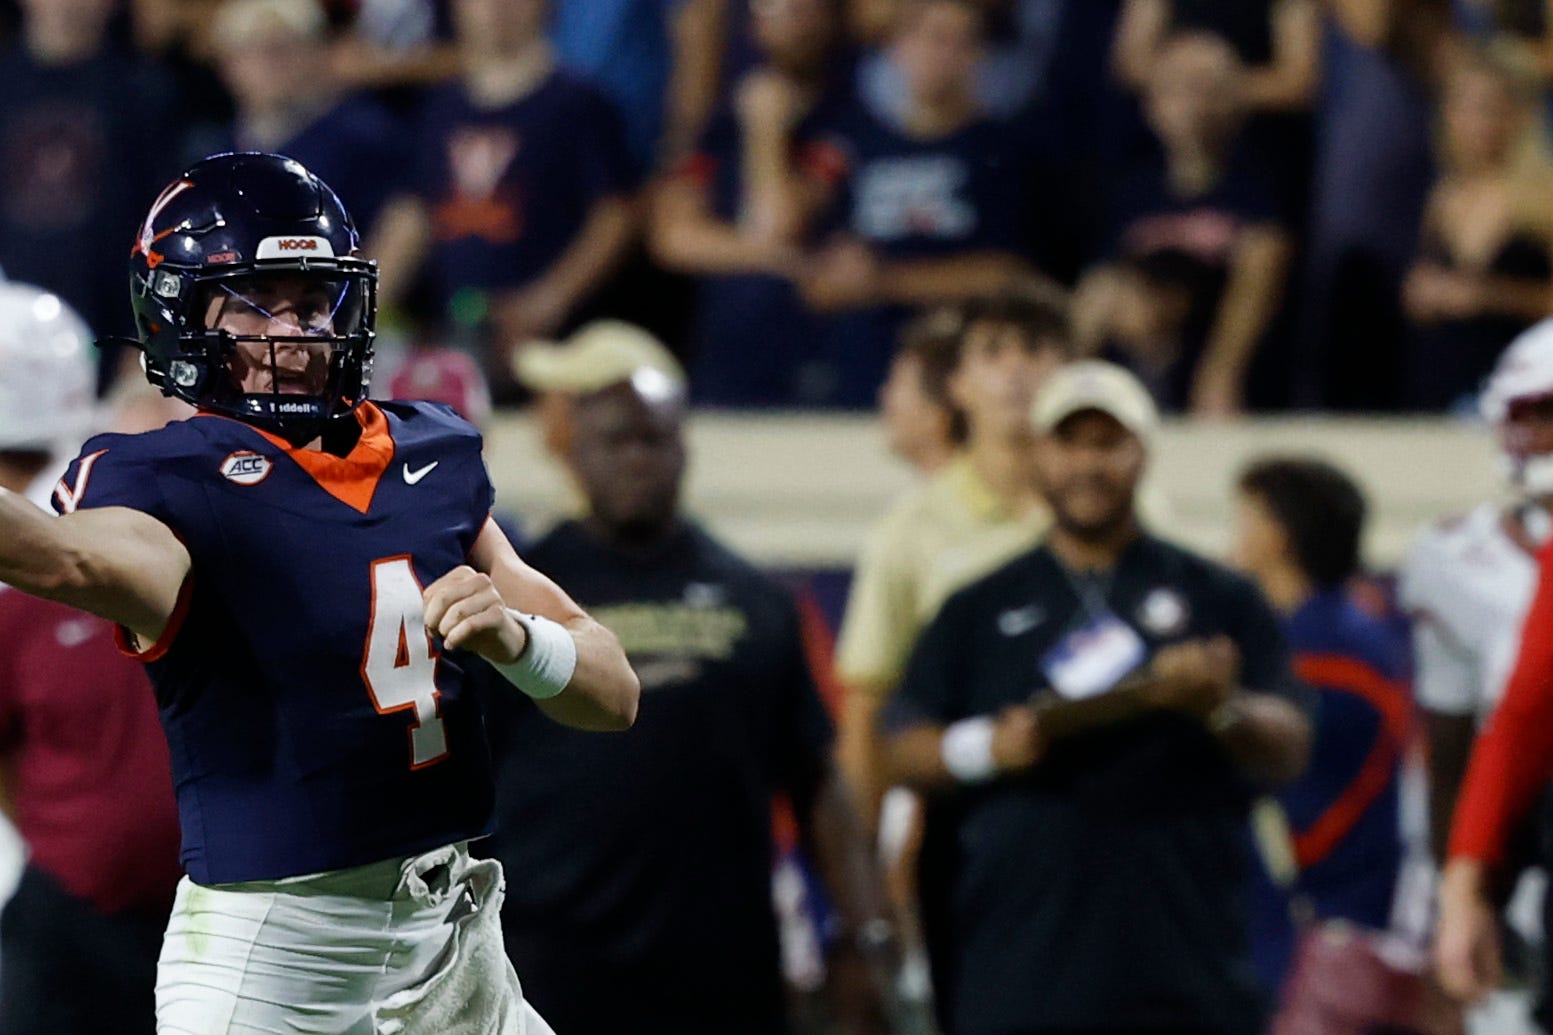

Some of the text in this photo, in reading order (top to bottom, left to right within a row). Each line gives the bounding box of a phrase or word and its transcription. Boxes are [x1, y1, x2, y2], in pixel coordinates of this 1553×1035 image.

[278, 239, 317, 250] HOOS
[228, 456, 264, 473] ACC
[359, 553, 450, 772] 4
